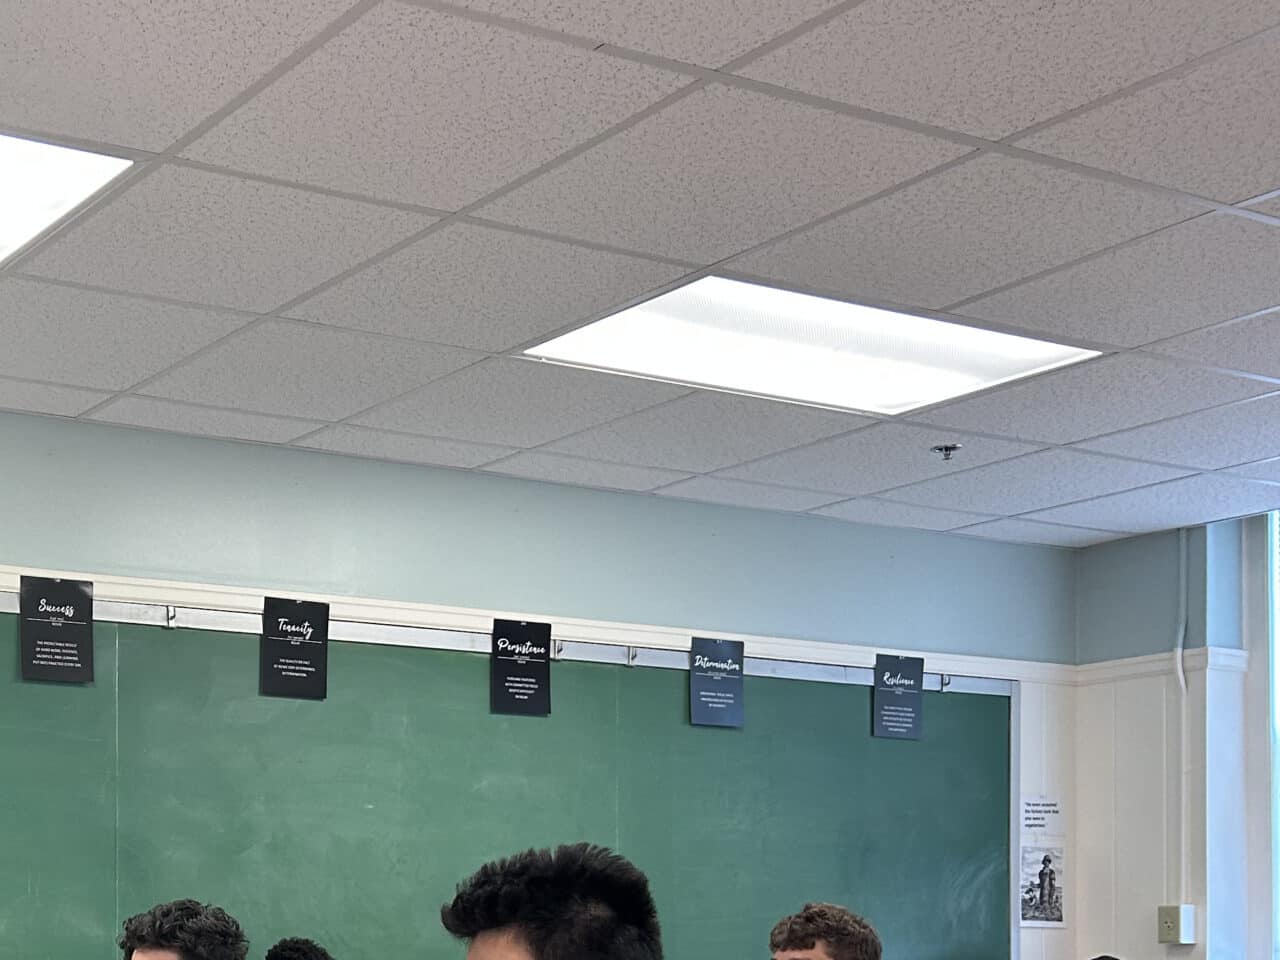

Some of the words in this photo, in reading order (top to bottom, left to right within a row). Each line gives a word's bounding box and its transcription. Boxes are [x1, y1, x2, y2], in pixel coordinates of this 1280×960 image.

[38, 598, 74, 617] Success
[277, 618, 315, 640] Tenacity
[497, 638, 547, 654] Persistence
[694, 655, 740, 672] Determination
